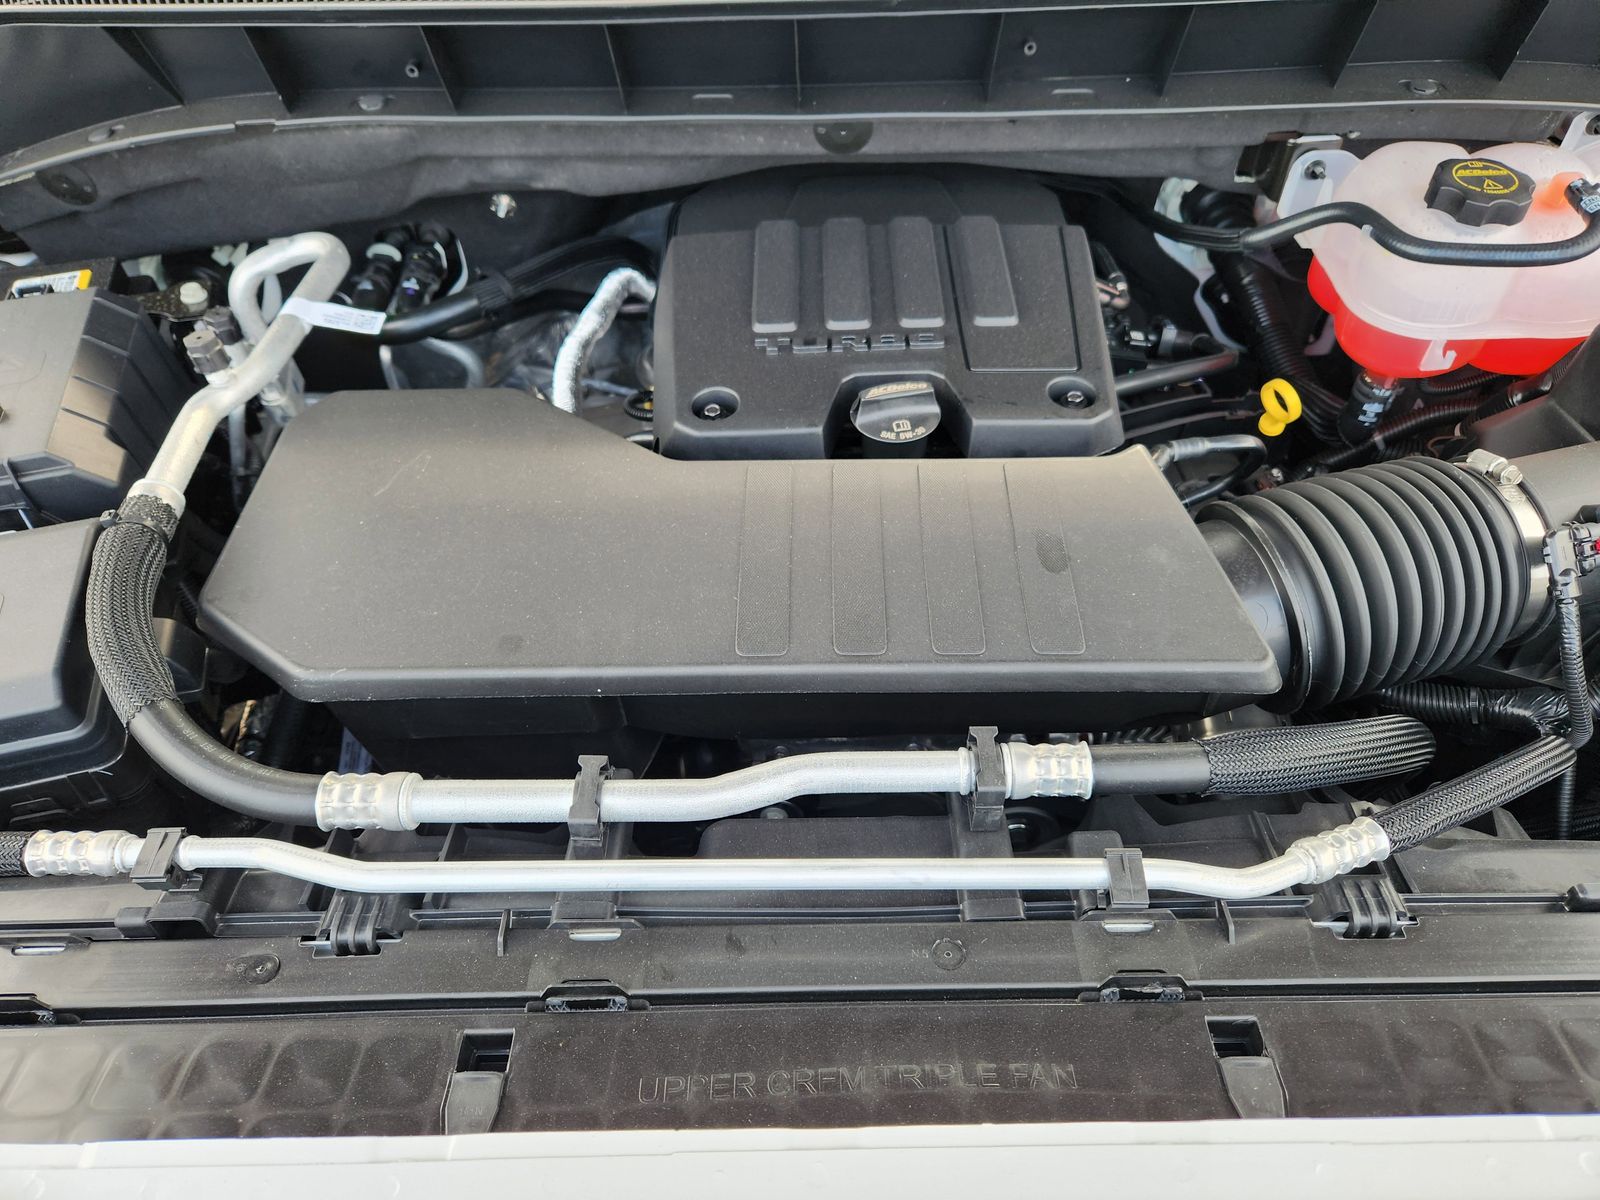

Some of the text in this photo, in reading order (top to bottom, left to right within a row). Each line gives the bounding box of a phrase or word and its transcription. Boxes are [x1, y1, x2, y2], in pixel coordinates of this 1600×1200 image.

[1455, 169, 1508, 177] ACDelco
[865, 382, 928, 399] ACDelco
[880, 430, 896, 440] SAE
[638, 1073, 756, 1103] UPPER
[874, 1063, 1000, 1089] TRIPLE
[1008, 1063, 1078, 1089] FAN
